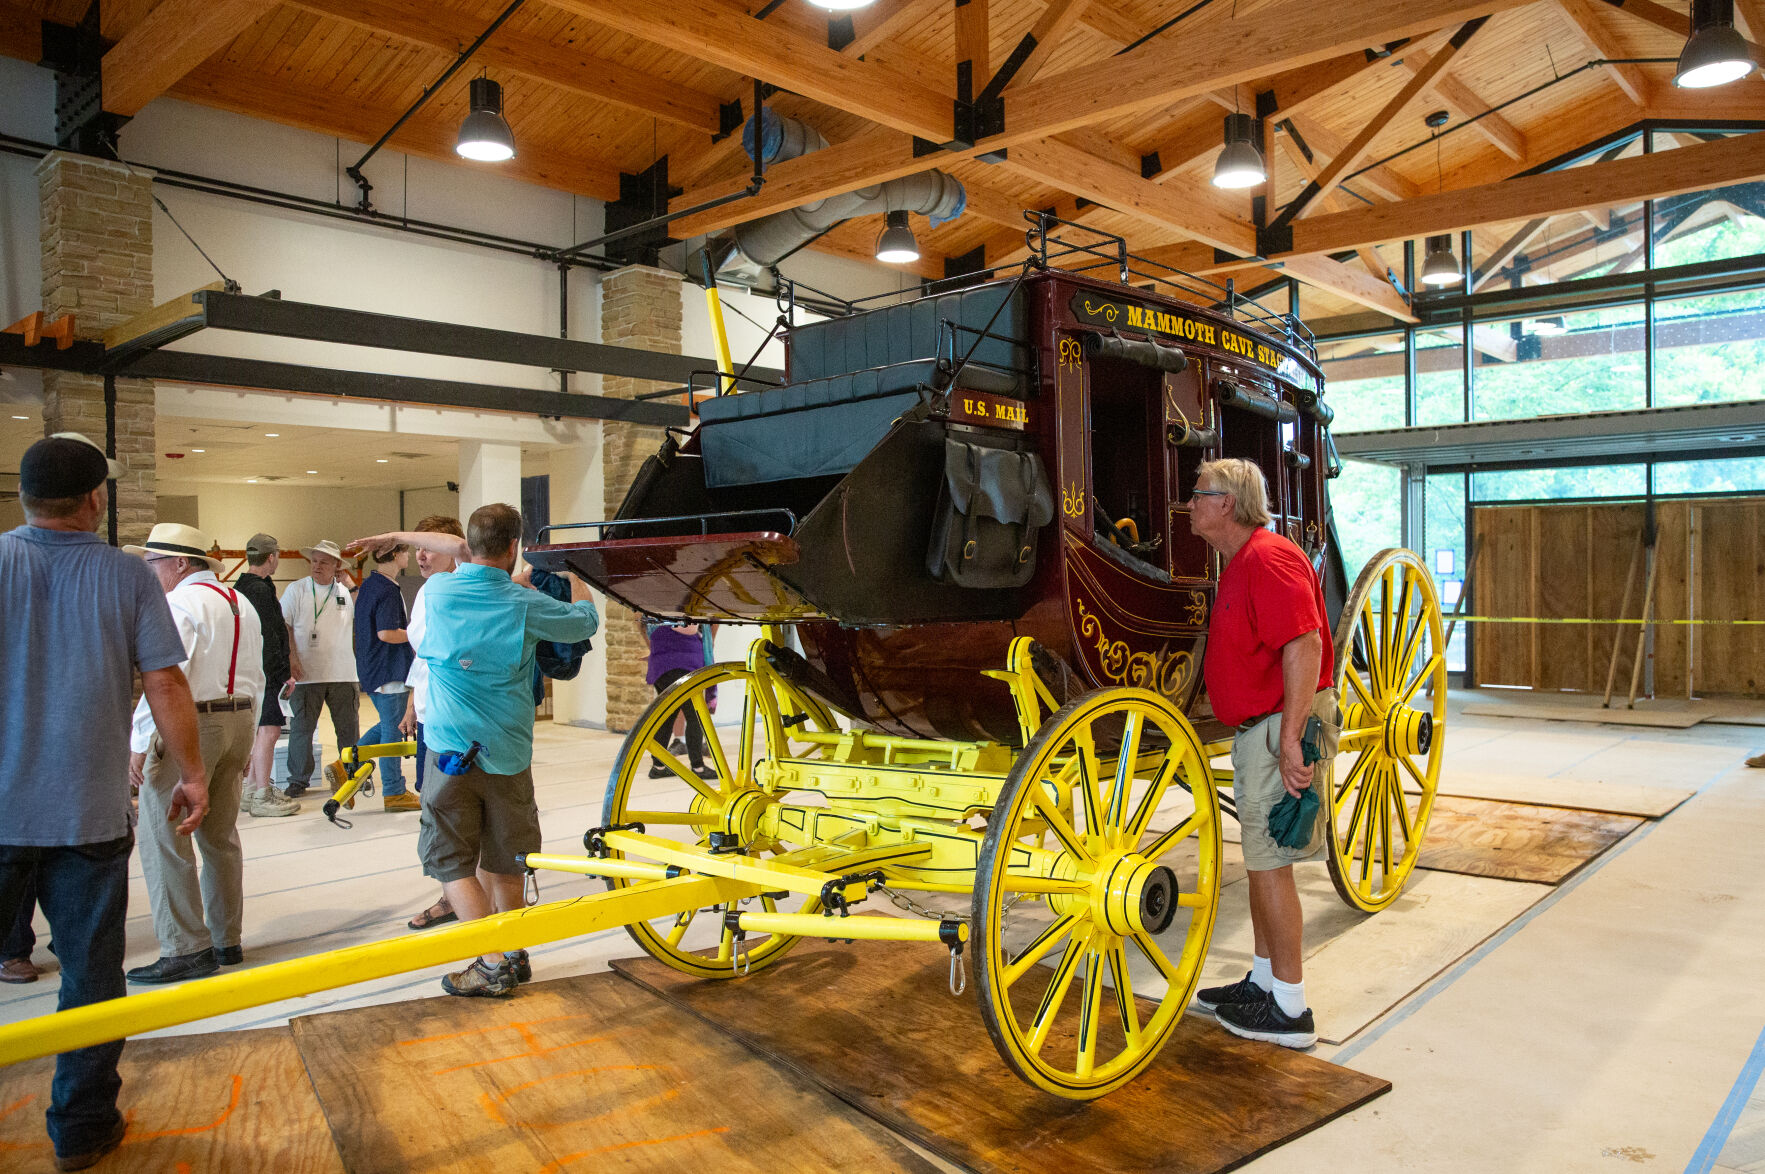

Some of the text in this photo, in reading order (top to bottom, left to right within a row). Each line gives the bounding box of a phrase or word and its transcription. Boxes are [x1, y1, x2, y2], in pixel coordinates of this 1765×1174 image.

[1127, 304, 1216, 345] MAMMOTH
[1221, 329, 1254, 359] CAVE
[963, 398, 1029, 424] U.S. MAIL
